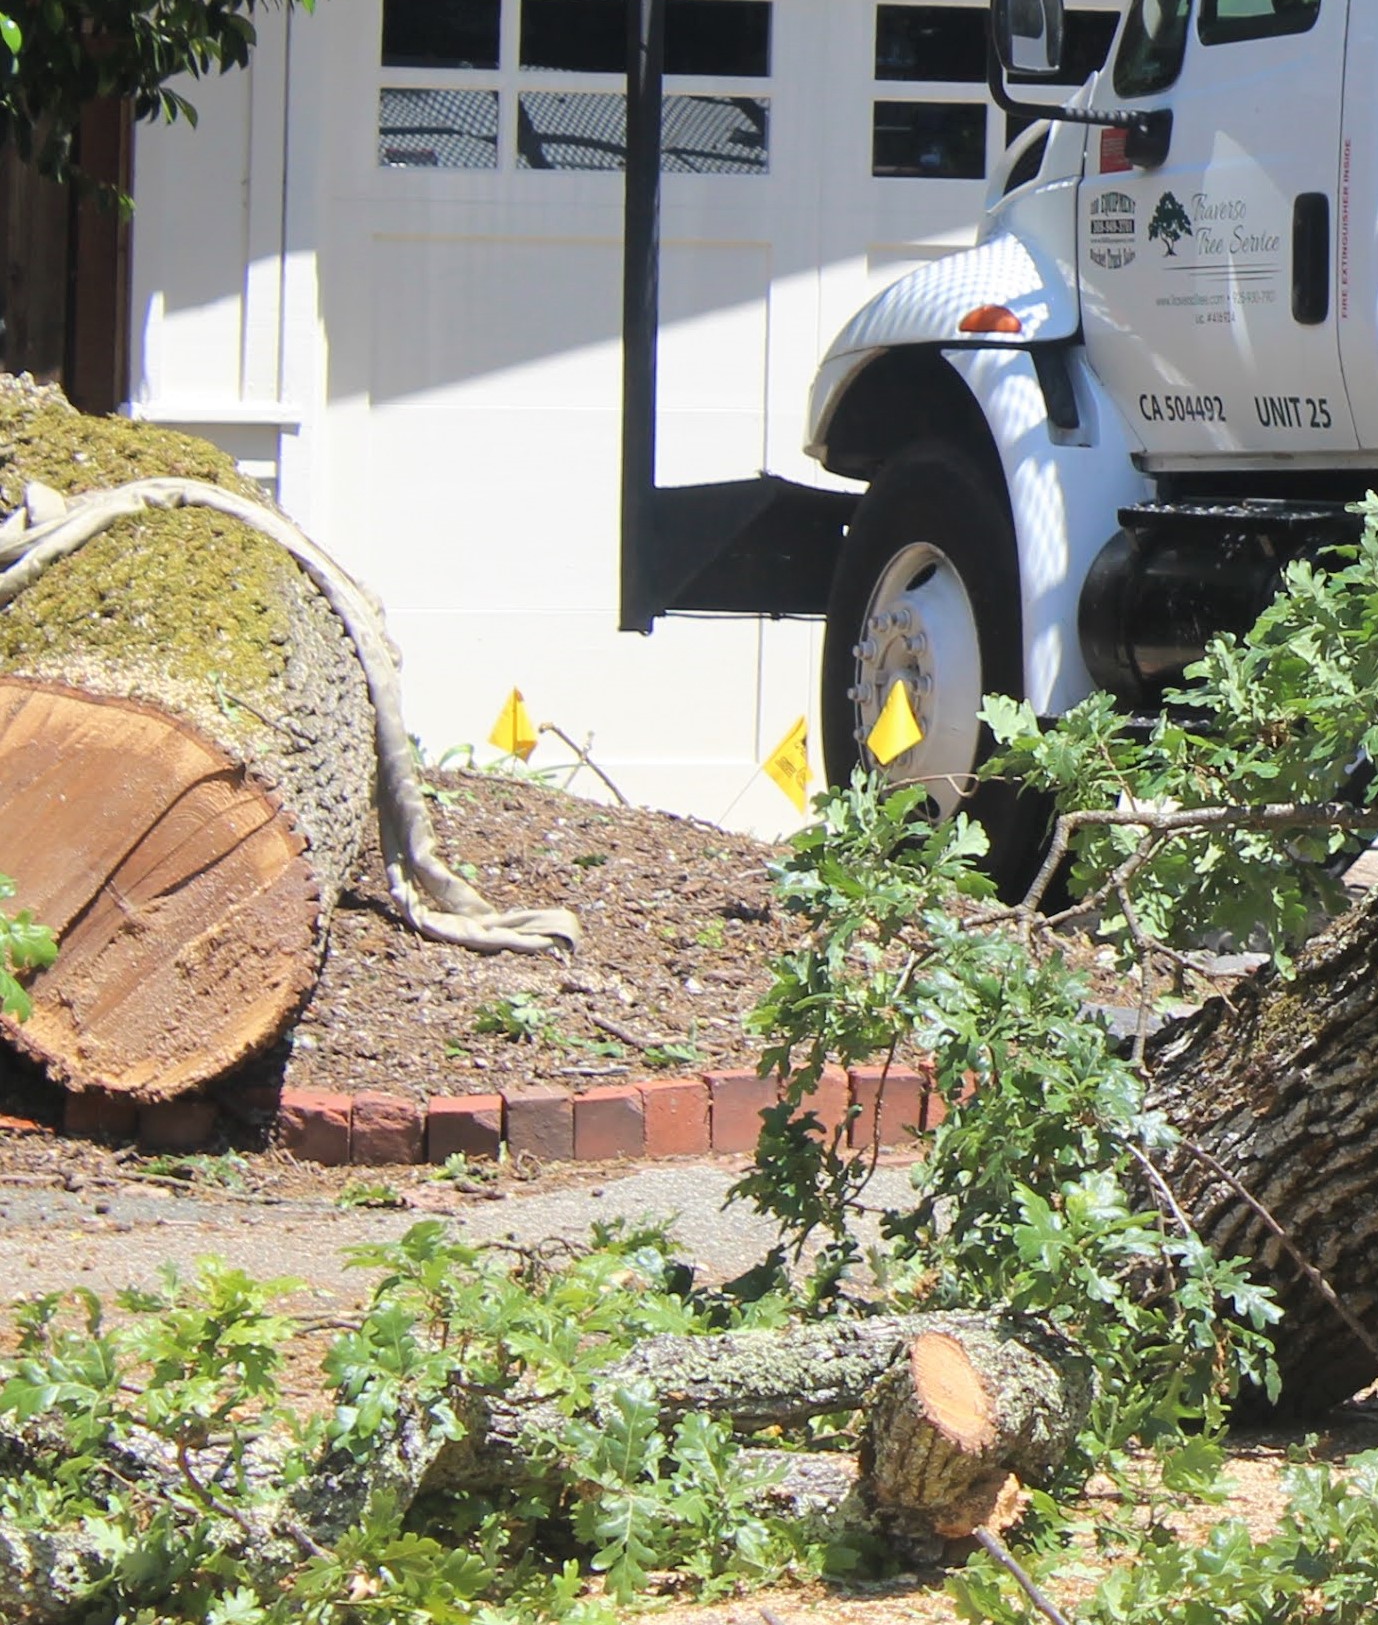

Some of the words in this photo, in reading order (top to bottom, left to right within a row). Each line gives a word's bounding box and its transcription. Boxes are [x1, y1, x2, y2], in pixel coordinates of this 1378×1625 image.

[1342, 139, 1352, 182] INSIDE
[1191, 193, 1246, 221] Traverso
[1196, 227, 1223, 255] Tree
[1229, 224, 1279, 254] Service
[1341, 183, 1350, 283] EXTINGUISHER
[1341, 287, 1349, 319] FIRE
[1139, 394, 1164, 421] CA
[1165, 395, 1226, 422] 504492
[1254, 396, 1302, 427] UNIT
[1305, 398, 1332, 428] 25
